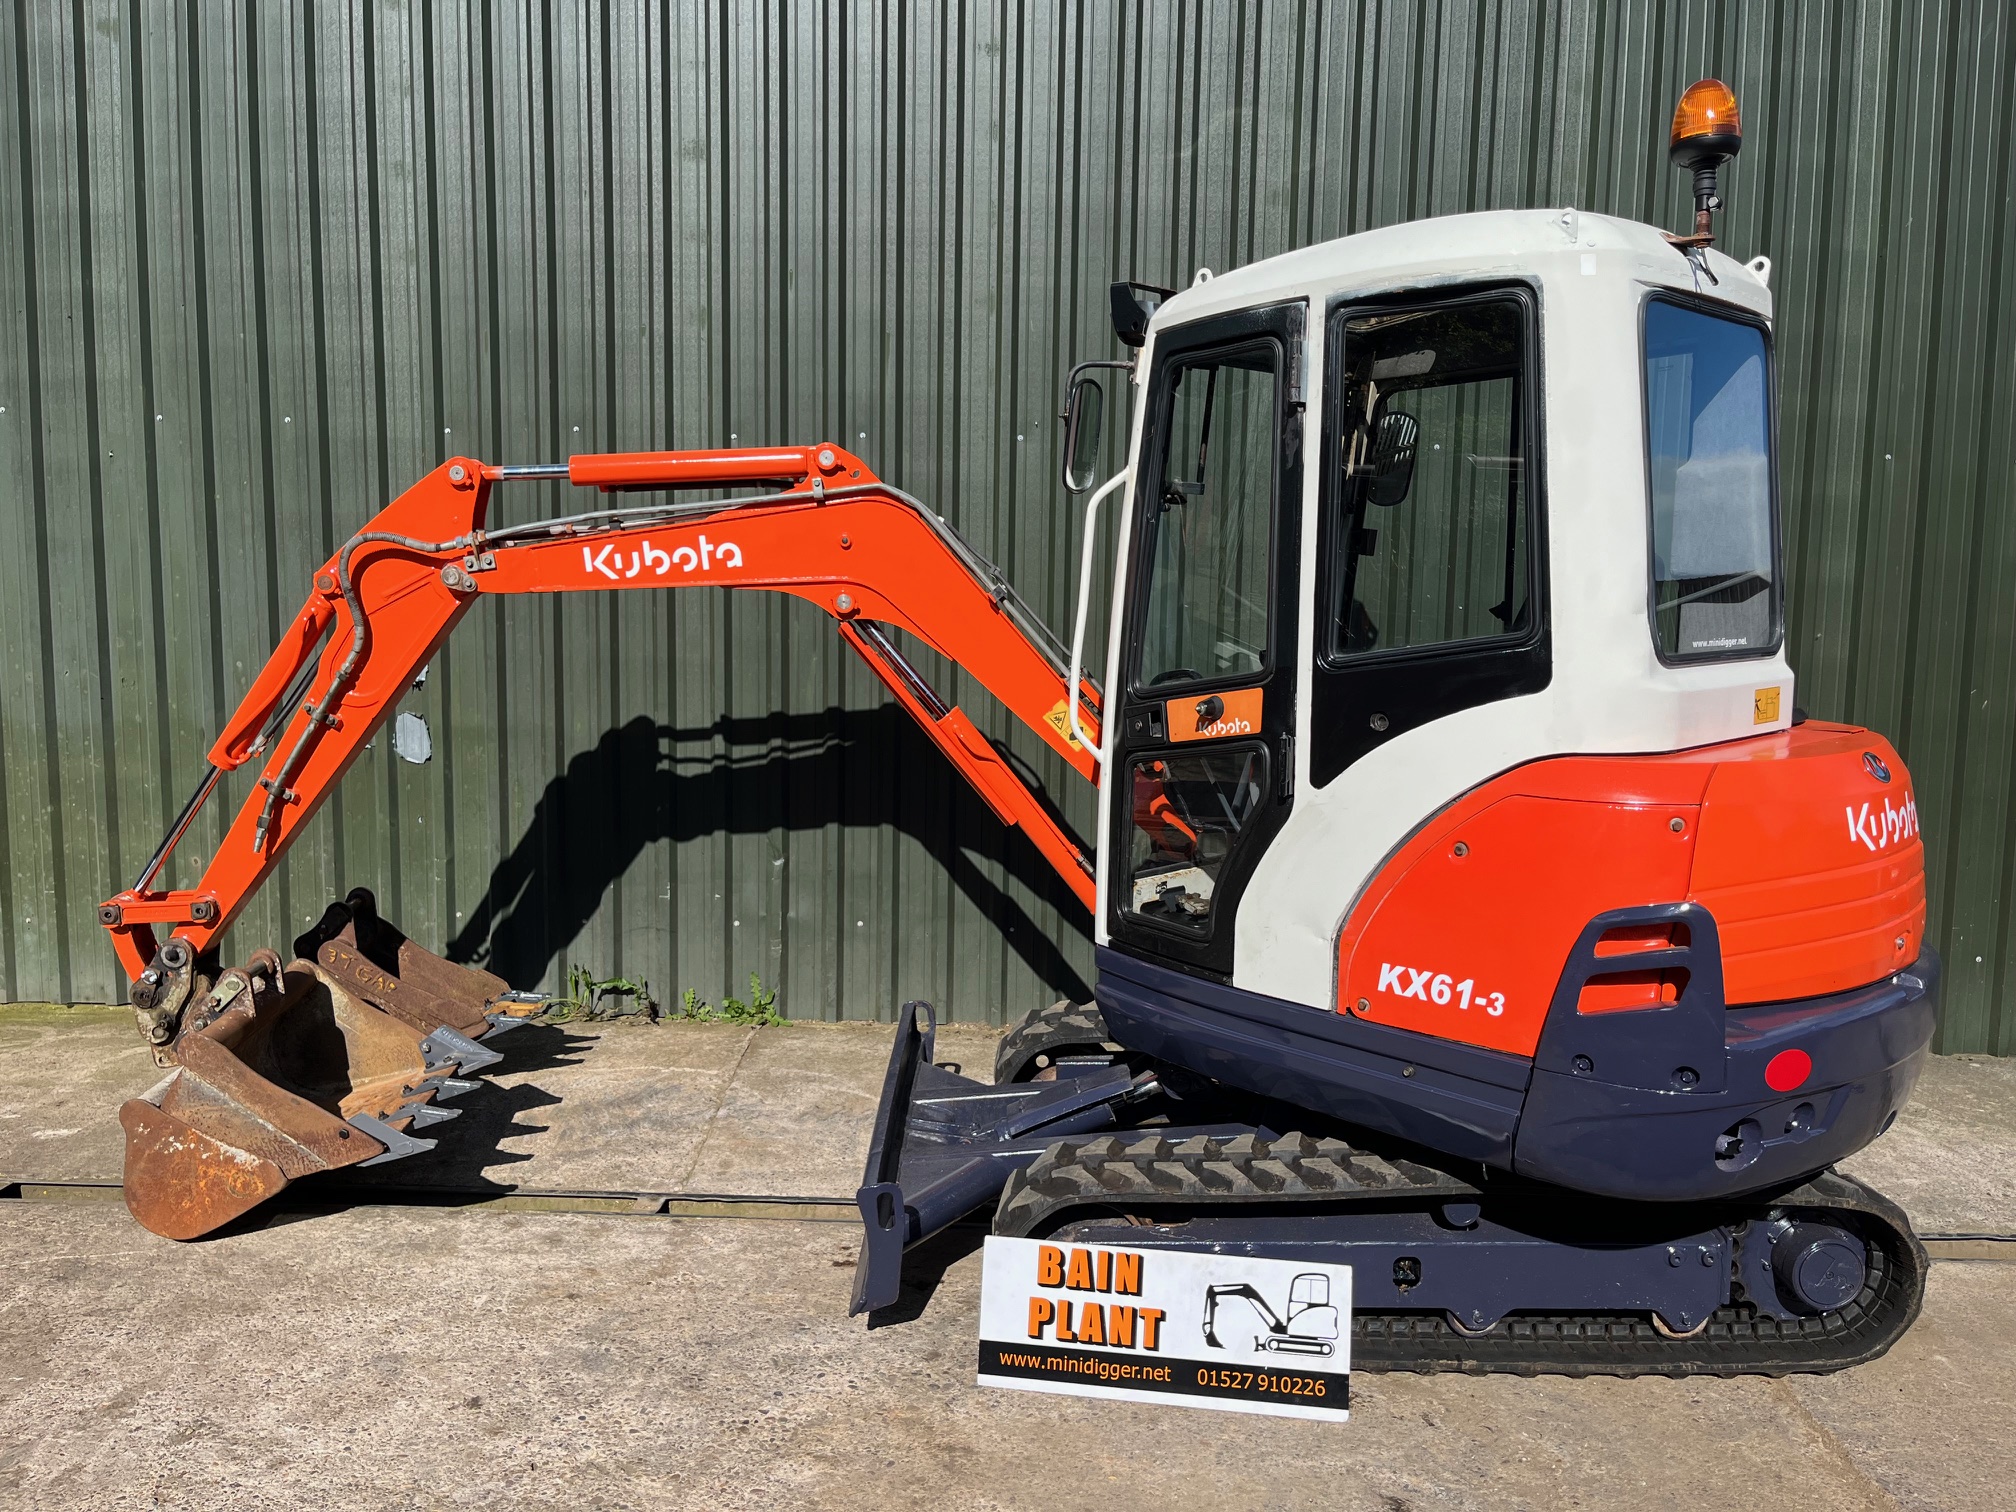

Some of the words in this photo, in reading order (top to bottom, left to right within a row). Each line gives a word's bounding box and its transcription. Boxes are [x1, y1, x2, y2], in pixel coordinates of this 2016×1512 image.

[583, 535, 743, 580] Kubota
[1692, 637, 1748, 648] www.minidigger.net
[1198, 717, 1251, 736] Kubota
[1846, 791, 1919, 851] Kubota
[1377, 962, 1505, 1017] KX61-3
[1037, 1245, 1144, 1296] BAIN
[1027, 1296, 1166, 1351] PLANT
[1000, 1351, 1172, 1382] www.minidigger.net
[1197, 1369, 1254, 1390] 01527
[1258, 1374, 1327, 1397] 910226
